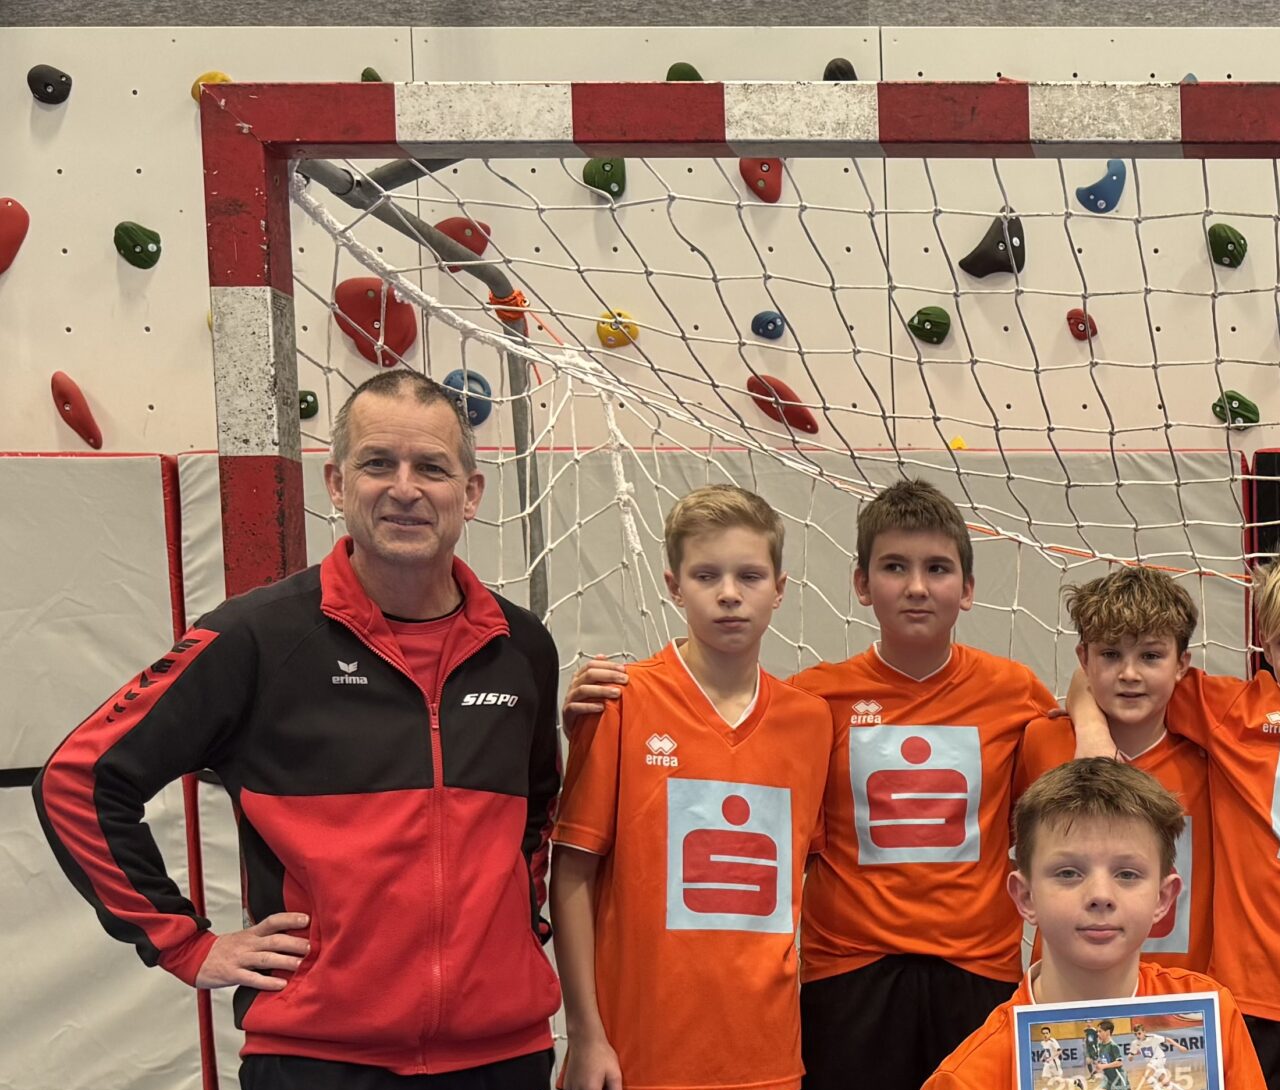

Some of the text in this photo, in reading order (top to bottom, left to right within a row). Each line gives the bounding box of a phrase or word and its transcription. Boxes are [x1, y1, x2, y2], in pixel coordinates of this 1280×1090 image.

[332, 674, 369, 685] erima
[461, 692, 519, 708] SISPO
[851, 713, 882, 725] errea
[646, 753, 679, 767] errea
